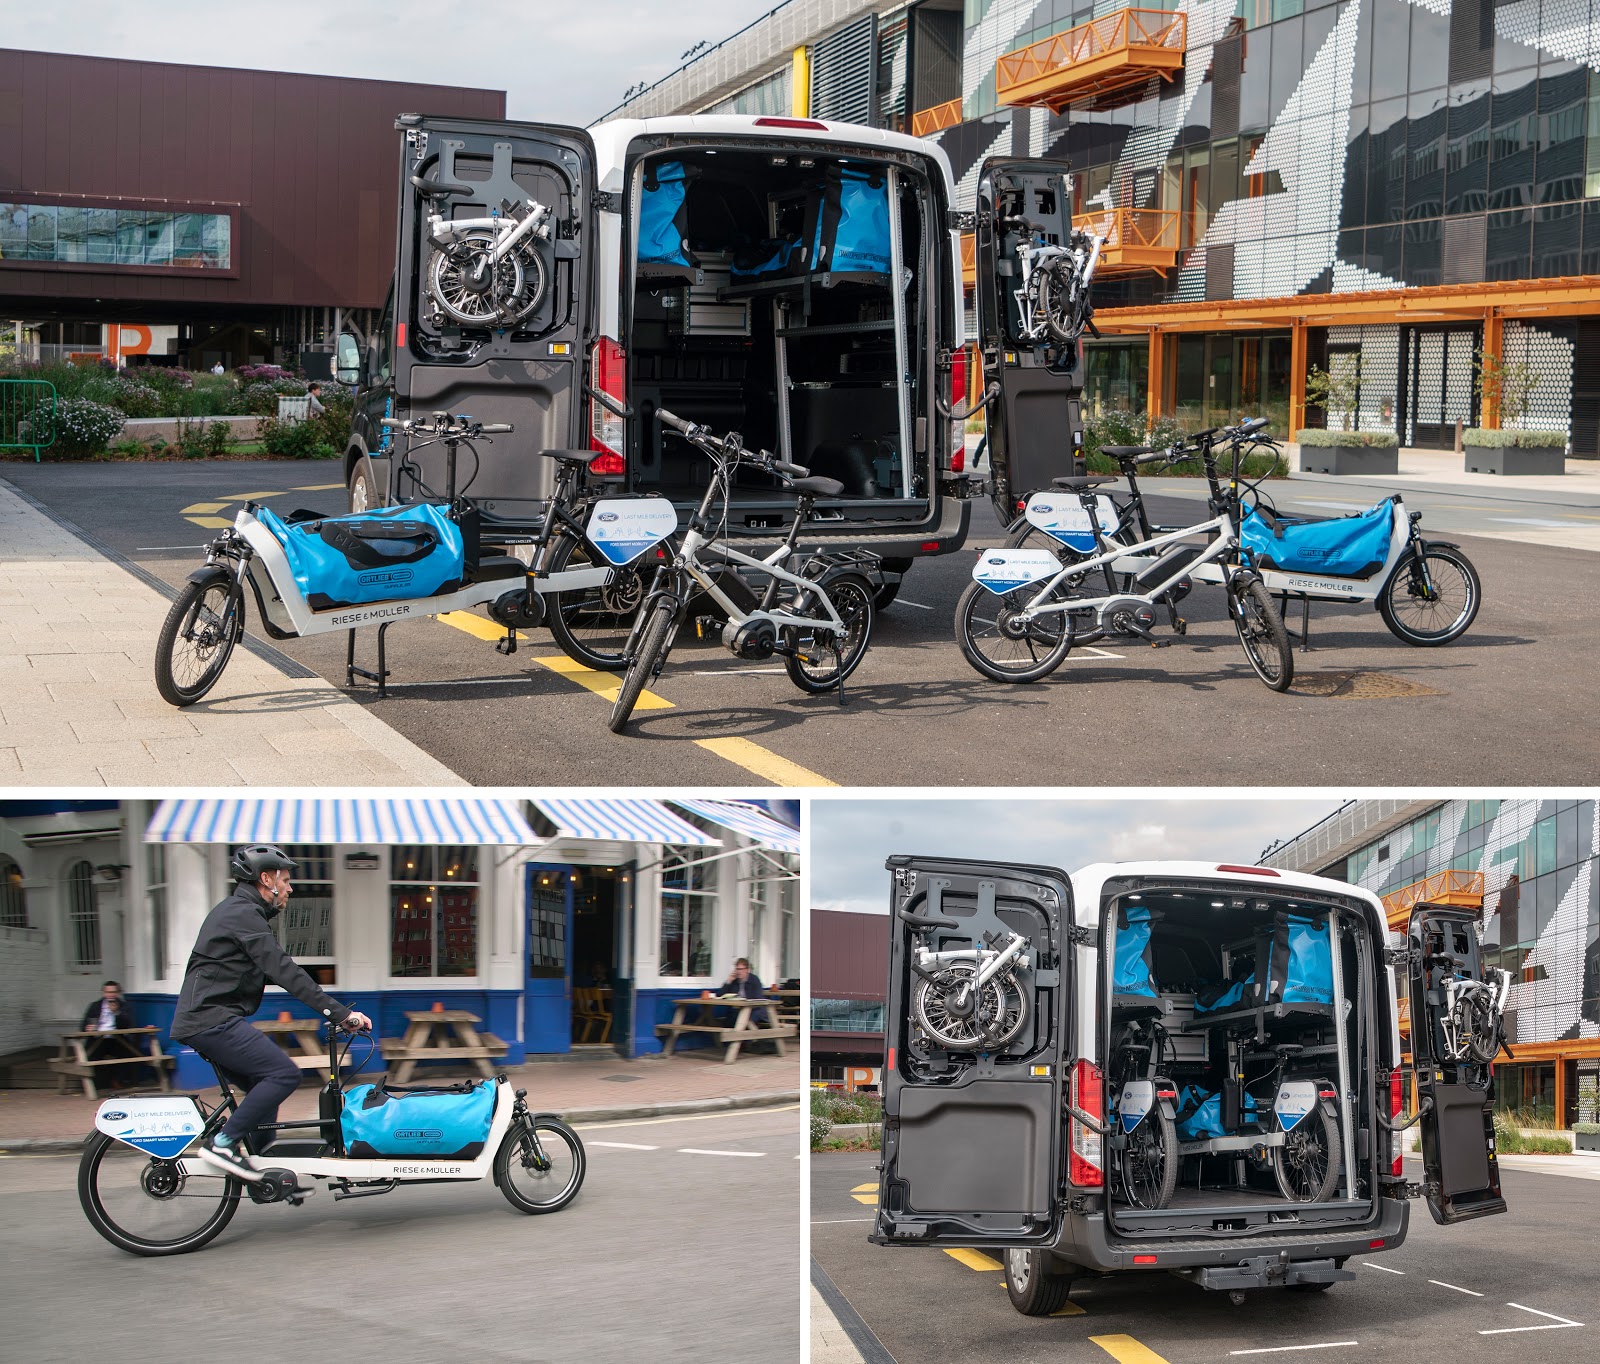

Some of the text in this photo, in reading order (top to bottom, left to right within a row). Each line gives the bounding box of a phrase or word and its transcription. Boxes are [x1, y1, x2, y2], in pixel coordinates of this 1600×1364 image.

[361, 574, 390, 583] ORTLIEB
[1288, 579, 1313, 588] RIESE
[1319, 582, 1353, 592] MÜLLER
[332, 613, 361, 625] RIESE
[370, 606, 410, 619] MÜLLER
[426, 1166, 461, 1174] MÜLLER
